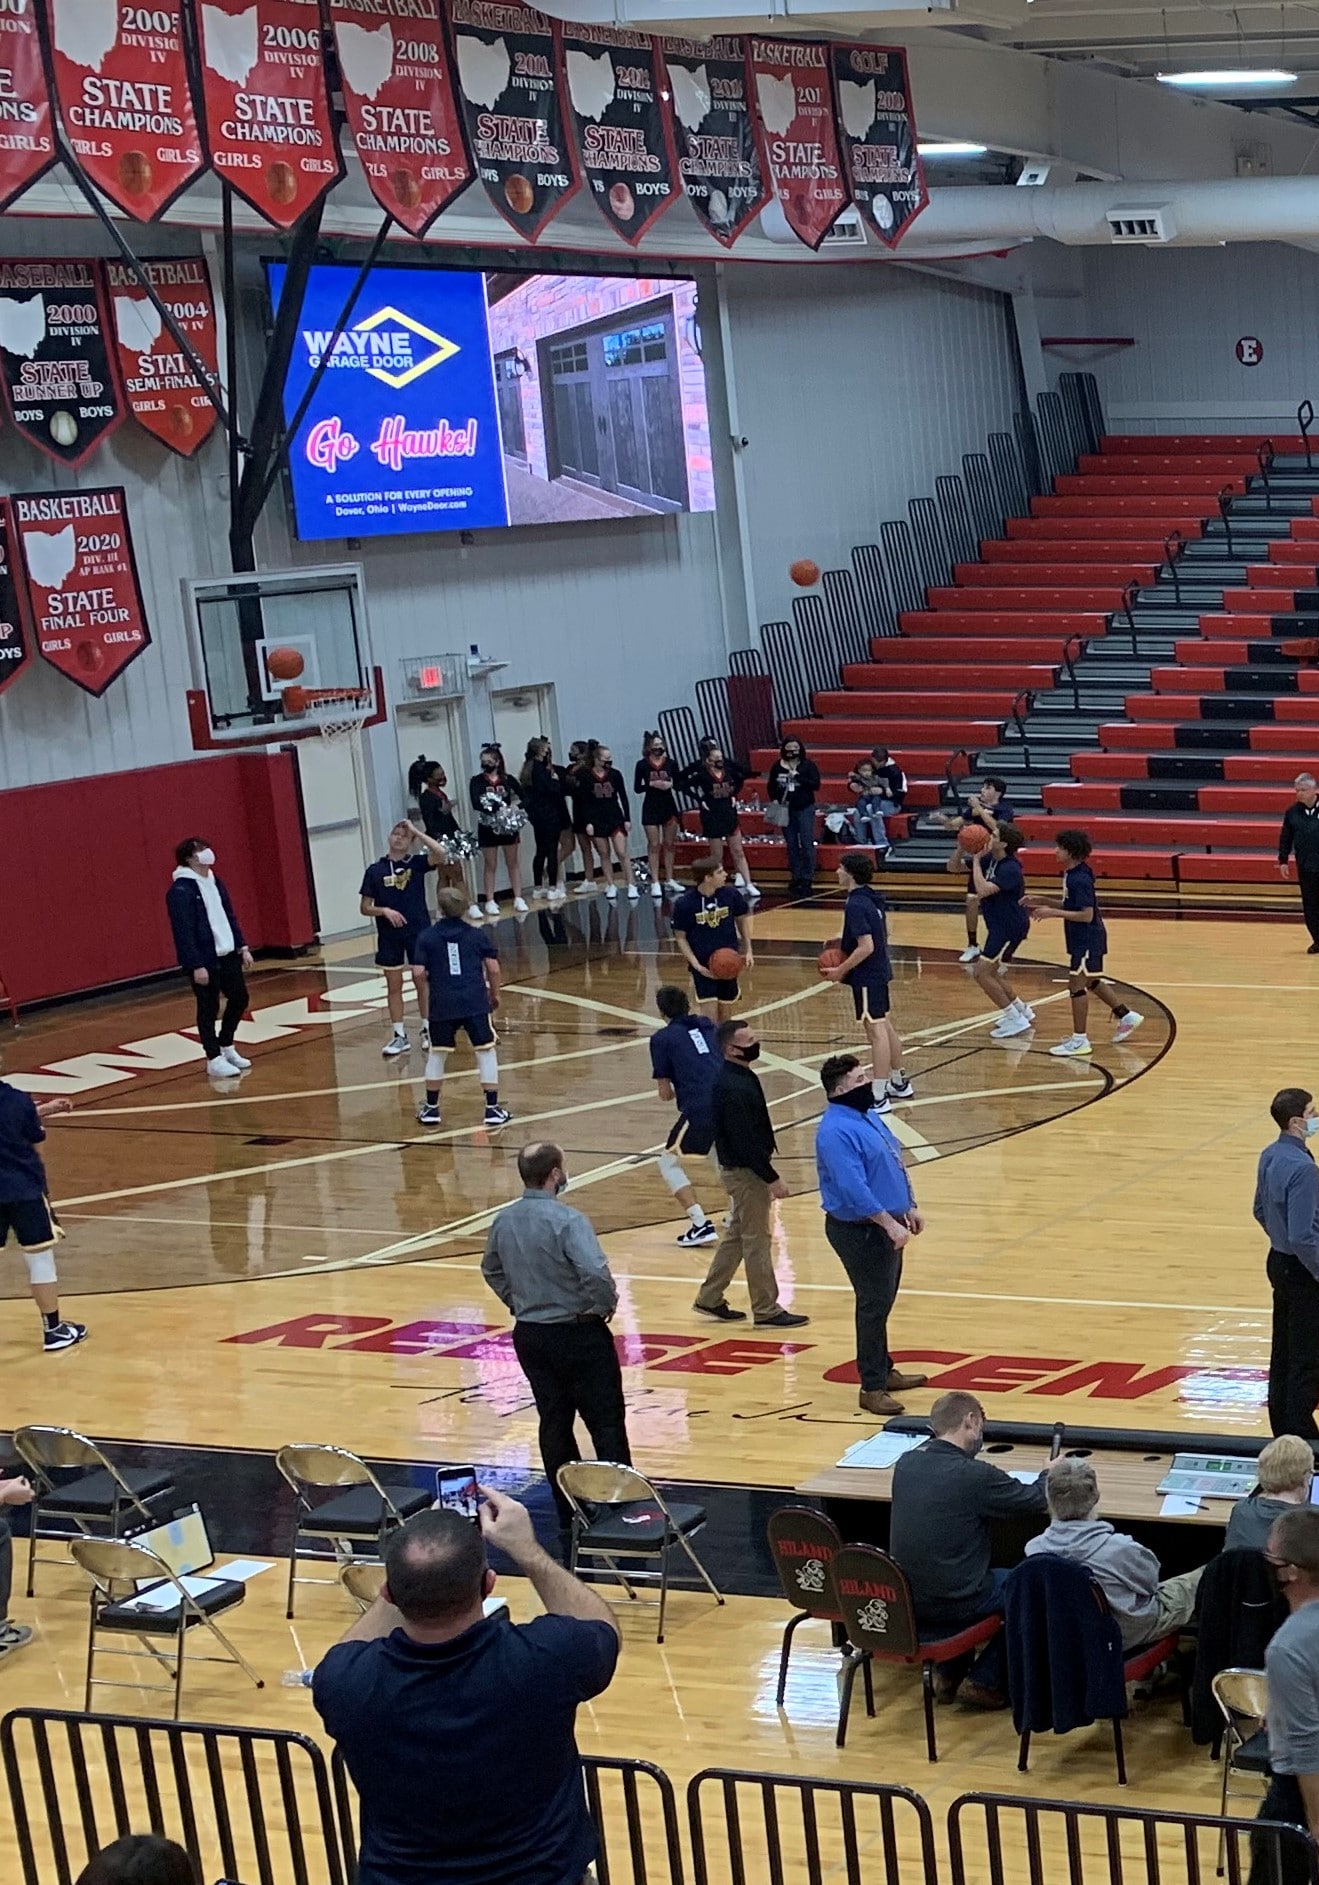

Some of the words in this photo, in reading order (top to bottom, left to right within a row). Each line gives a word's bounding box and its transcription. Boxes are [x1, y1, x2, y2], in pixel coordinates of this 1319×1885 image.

[263, 25, 320, 49] 2006
[150, 50, 167, 63] IV
[396, 40, 439, 63] 2008
[752, 40, 826, 68] BASKETBALL
[290, 66, 304, 79] IV
[395, 64, 442, 80] DIVISION
[850, 50, 888, 75] GOLF
[82, 76, 172, 114] STATE
[234, 92, 315, 126] STATE
[69, 106, 184, 136] CHAMPIONS
[361, 105, 435, 136] STATE
[477, 113, 549, 146] STATE
[221, 121, 323, 147] CHAMPIONS
[584, 124, 647, 155] STATE
[356, 133, 450, 156] CHAMPIONS
[687, 134, 739, 161] STATE
[772, 142, 826, 164] STATE
[156, 147, 200, 163] GIRLS
[213, 151, 262, 169] GIRLS
[300, 157, 334, 174] GIRLS
[421, 162, 466, 181] GIRLS
[537, 173, 570, 187] BOYS
[636, 183, 671, 196] BOYS
[0, 264, 93, 288] ASEBALL
[47, 304, 97, 324] 2000
[49, 326, 99, 336] DIVISION
[71, 336, 81, 347] IV
[303, 331, 412, 355] WAYNE
[1240, 339, 1258, 364] E
[308, 355, 370, 368] GRAGE
[372, 356, 413, 368] DOOR
[20, 360, 92, 385] STATE
[12, 383, 78, 401] RUNNER
[80, 382, 103, 398] UP
[14, 410, 44, 422] BOYS
[79, 406, 114, 418] BOYS
[133, 400, 166, 412] GIRLS
[306, 415, 360, 473] Go
[370, 415, 478, 471] Hawks!
[325, 495, 334, 504] A
[335, 491, 382, 504] SOLUTION
[384, 490, 403, 502] FOR
[405, 487, 431, 500] EVERY
[432, 486, 473, 498] OPENING
[17, 494, 120, 521] BASKETBALL
[366, 504, 389, 515] Ohio
[77, 533, 120, 552] 2020
[83, 555, 105, 566] DIV.
[79, 566, 90, 577] AP
[48, 588, 116, 614] STATE
[41, 615, 85, 631] FINAL
[90, 608, 130, 626] FOUR
[42, 638, 72, 652] GIRLS
[104, 630, 142, 644] GIRLS
[839, 1579, 897, 1602] HILAND
